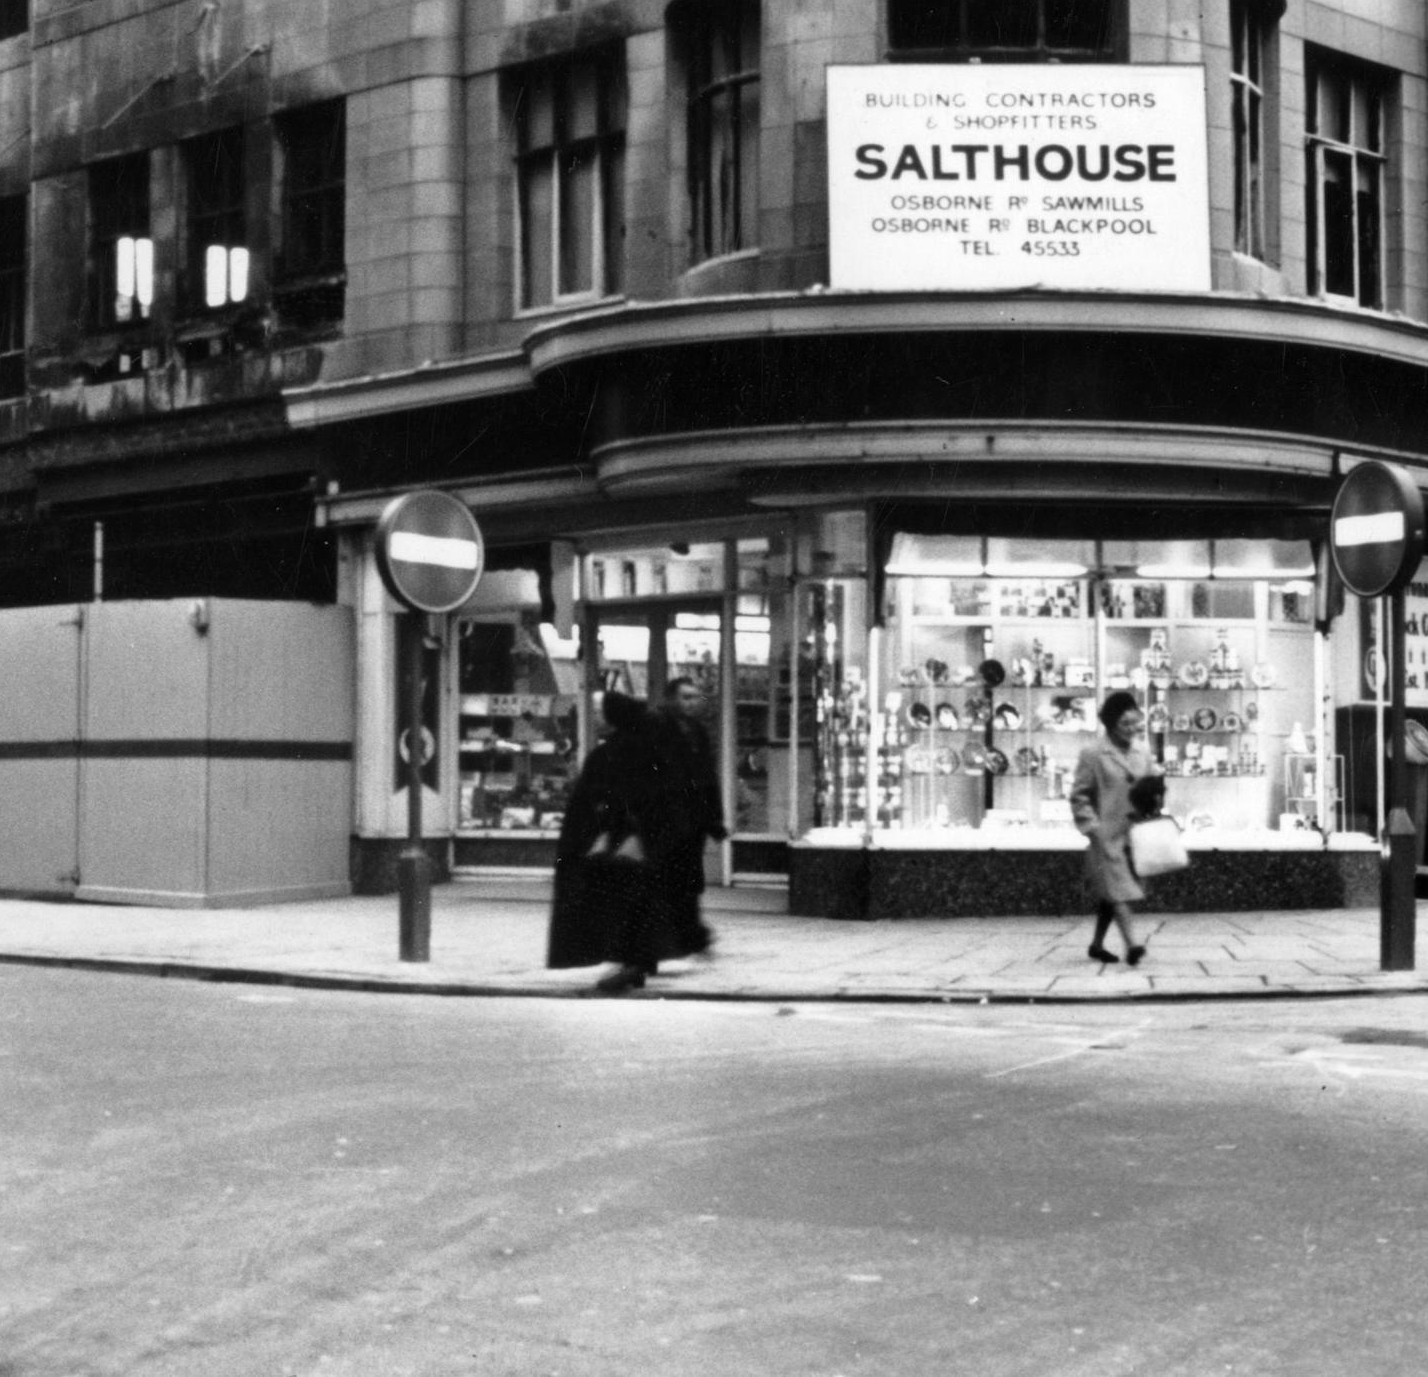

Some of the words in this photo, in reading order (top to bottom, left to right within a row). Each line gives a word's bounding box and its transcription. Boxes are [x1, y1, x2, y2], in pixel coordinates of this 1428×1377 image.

[865, 93, 966, 107] BUILDING
[985, 93, 1156, 108] CONTRACTORS
[953, 115, 1097, 130] SHOPFITTERS
[854, 143, 1177, 182] SALTHOUSE
[890, 195, 994, 211] OSBORNE
[1042, 196, 1144, 212] SAWMILLS
[871, 218, 971, 233] OSBORNE
[1027, 219, 1157, 234] BLACKPOOL
[1020, 240, 1080, 257] 45533
